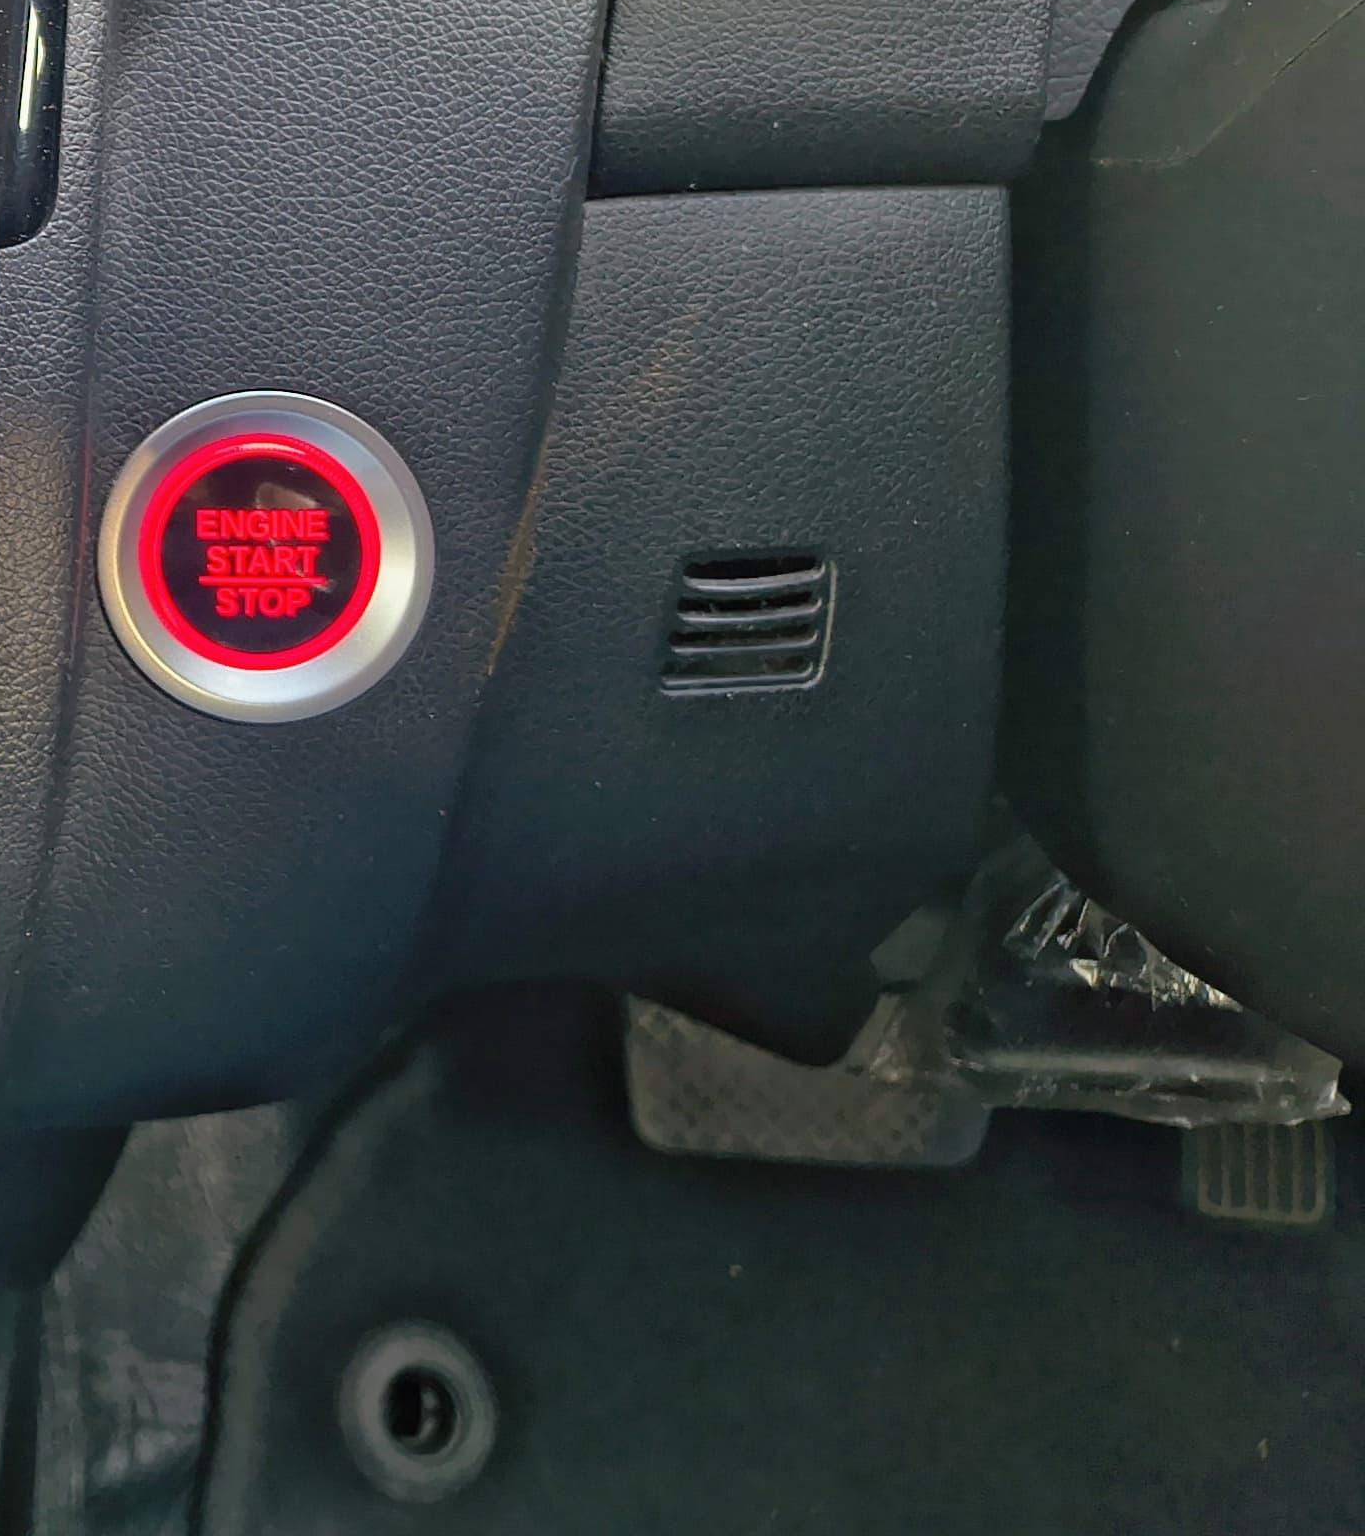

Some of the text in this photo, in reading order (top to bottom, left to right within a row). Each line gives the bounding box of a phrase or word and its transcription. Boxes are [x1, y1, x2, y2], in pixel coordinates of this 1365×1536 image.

[195, 509, 329, 541] ENGINE
[206, 546, 320, 575] START
[215, 588, 311, 617] STOP
